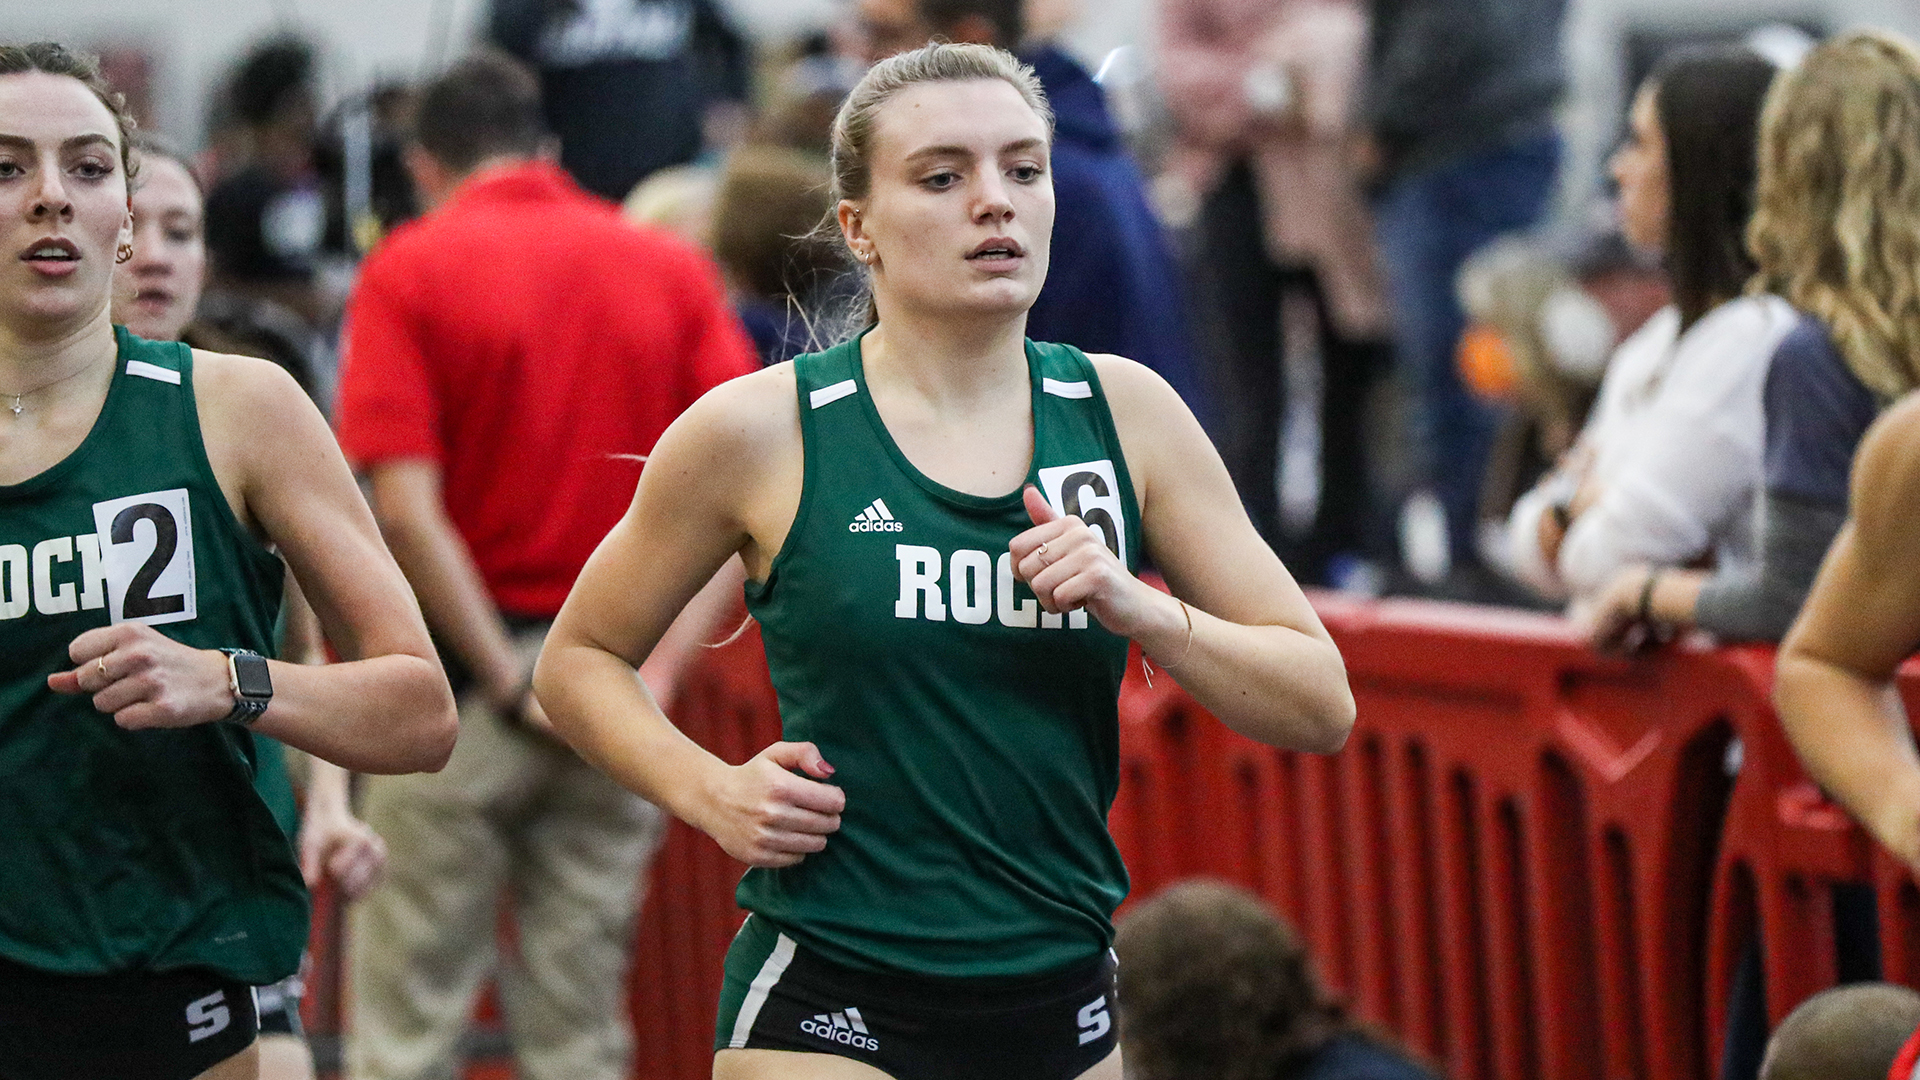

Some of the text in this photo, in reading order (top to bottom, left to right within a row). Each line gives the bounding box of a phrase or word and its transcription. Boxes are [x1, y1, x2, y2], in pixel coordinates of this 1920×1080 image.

[848, 518, 904, 533] adidas
[1061, 471, 1119, 562] 6
[111, 502, 185, 619] 2
[895, 543, 1088, 630] ROC
[186, 989, 230, 1044] S
[799, 1019, 880, 1051] adidas
[1077, 995, 1111, 1045] S
